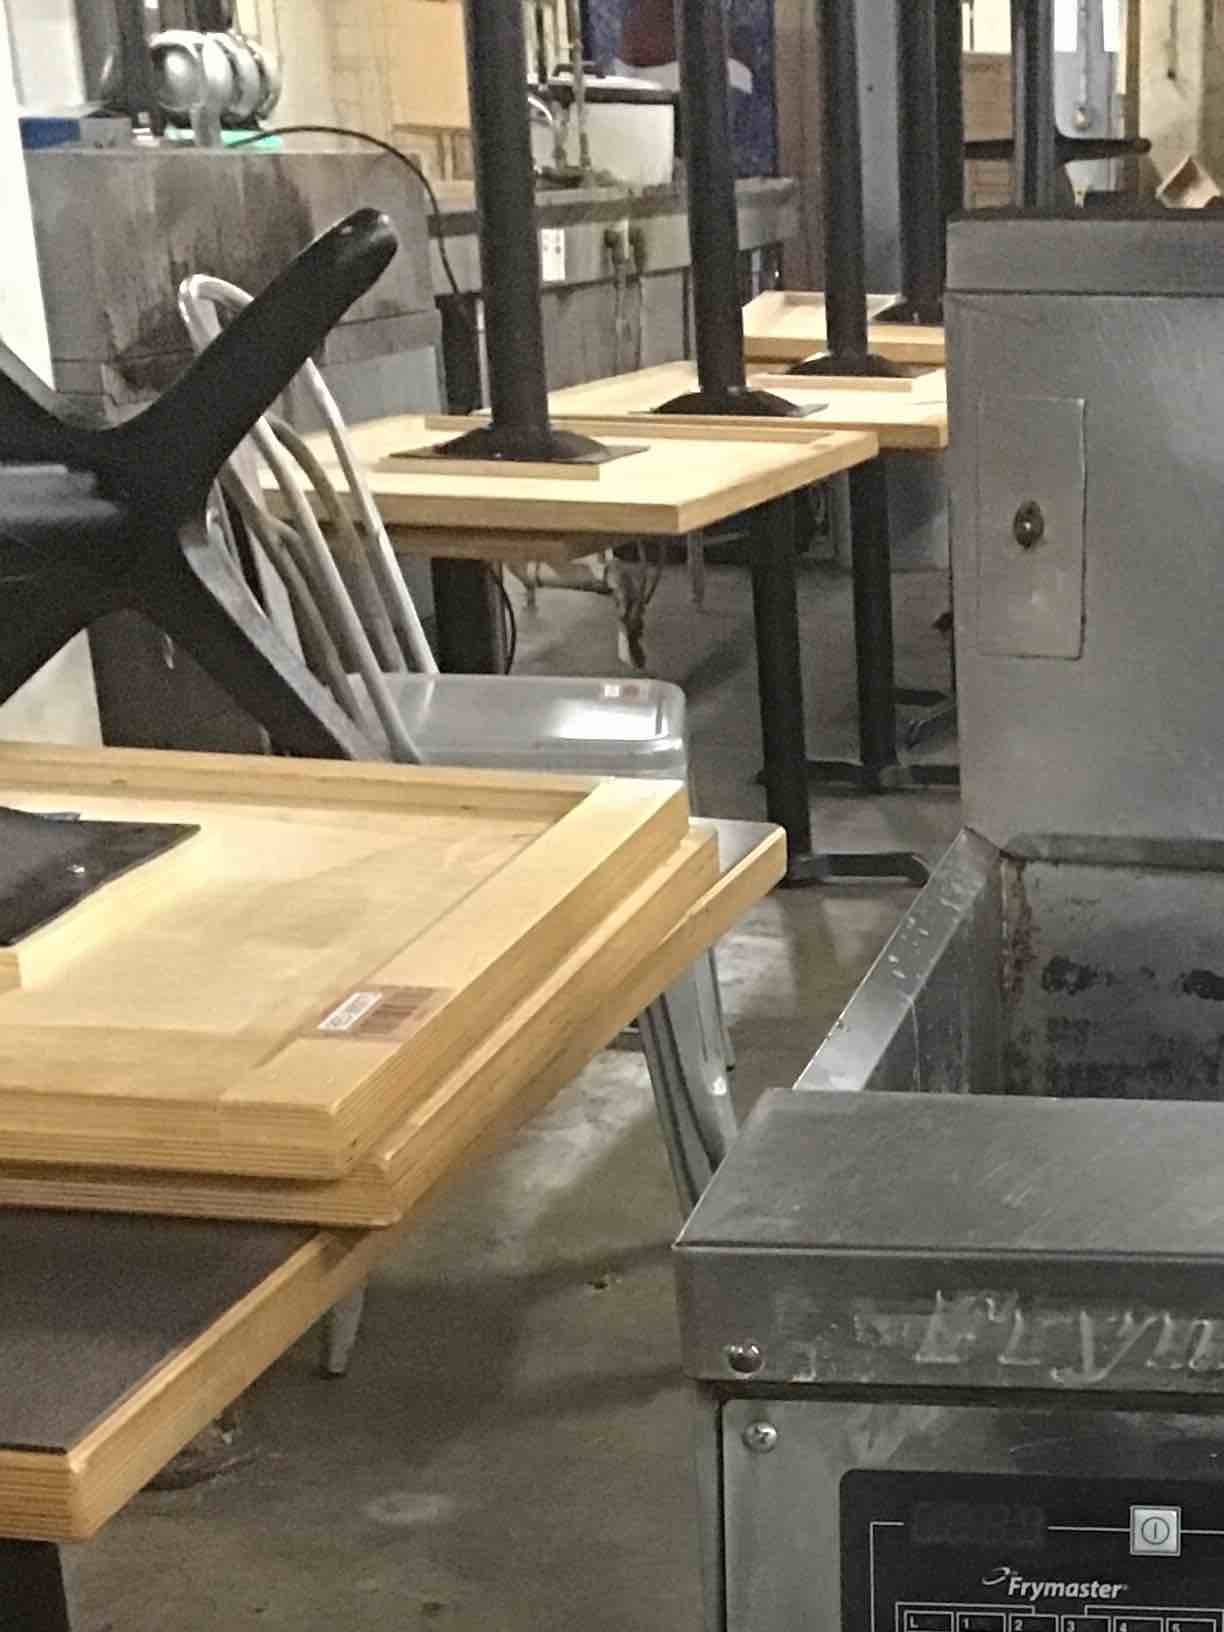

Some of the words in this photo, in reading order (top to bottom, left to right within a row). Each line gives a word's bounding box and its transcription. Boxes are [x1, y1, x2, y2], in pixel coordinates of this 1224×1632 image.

[1008, 1576, 1122, 1601] Frymaster
[962, 1618, 970, 1629] 1
[1014, 1620, 1024, 1631] 2
[1067, 1621, 1076, 1632] 3
[1119, 1622, 1128, 1632] 4
